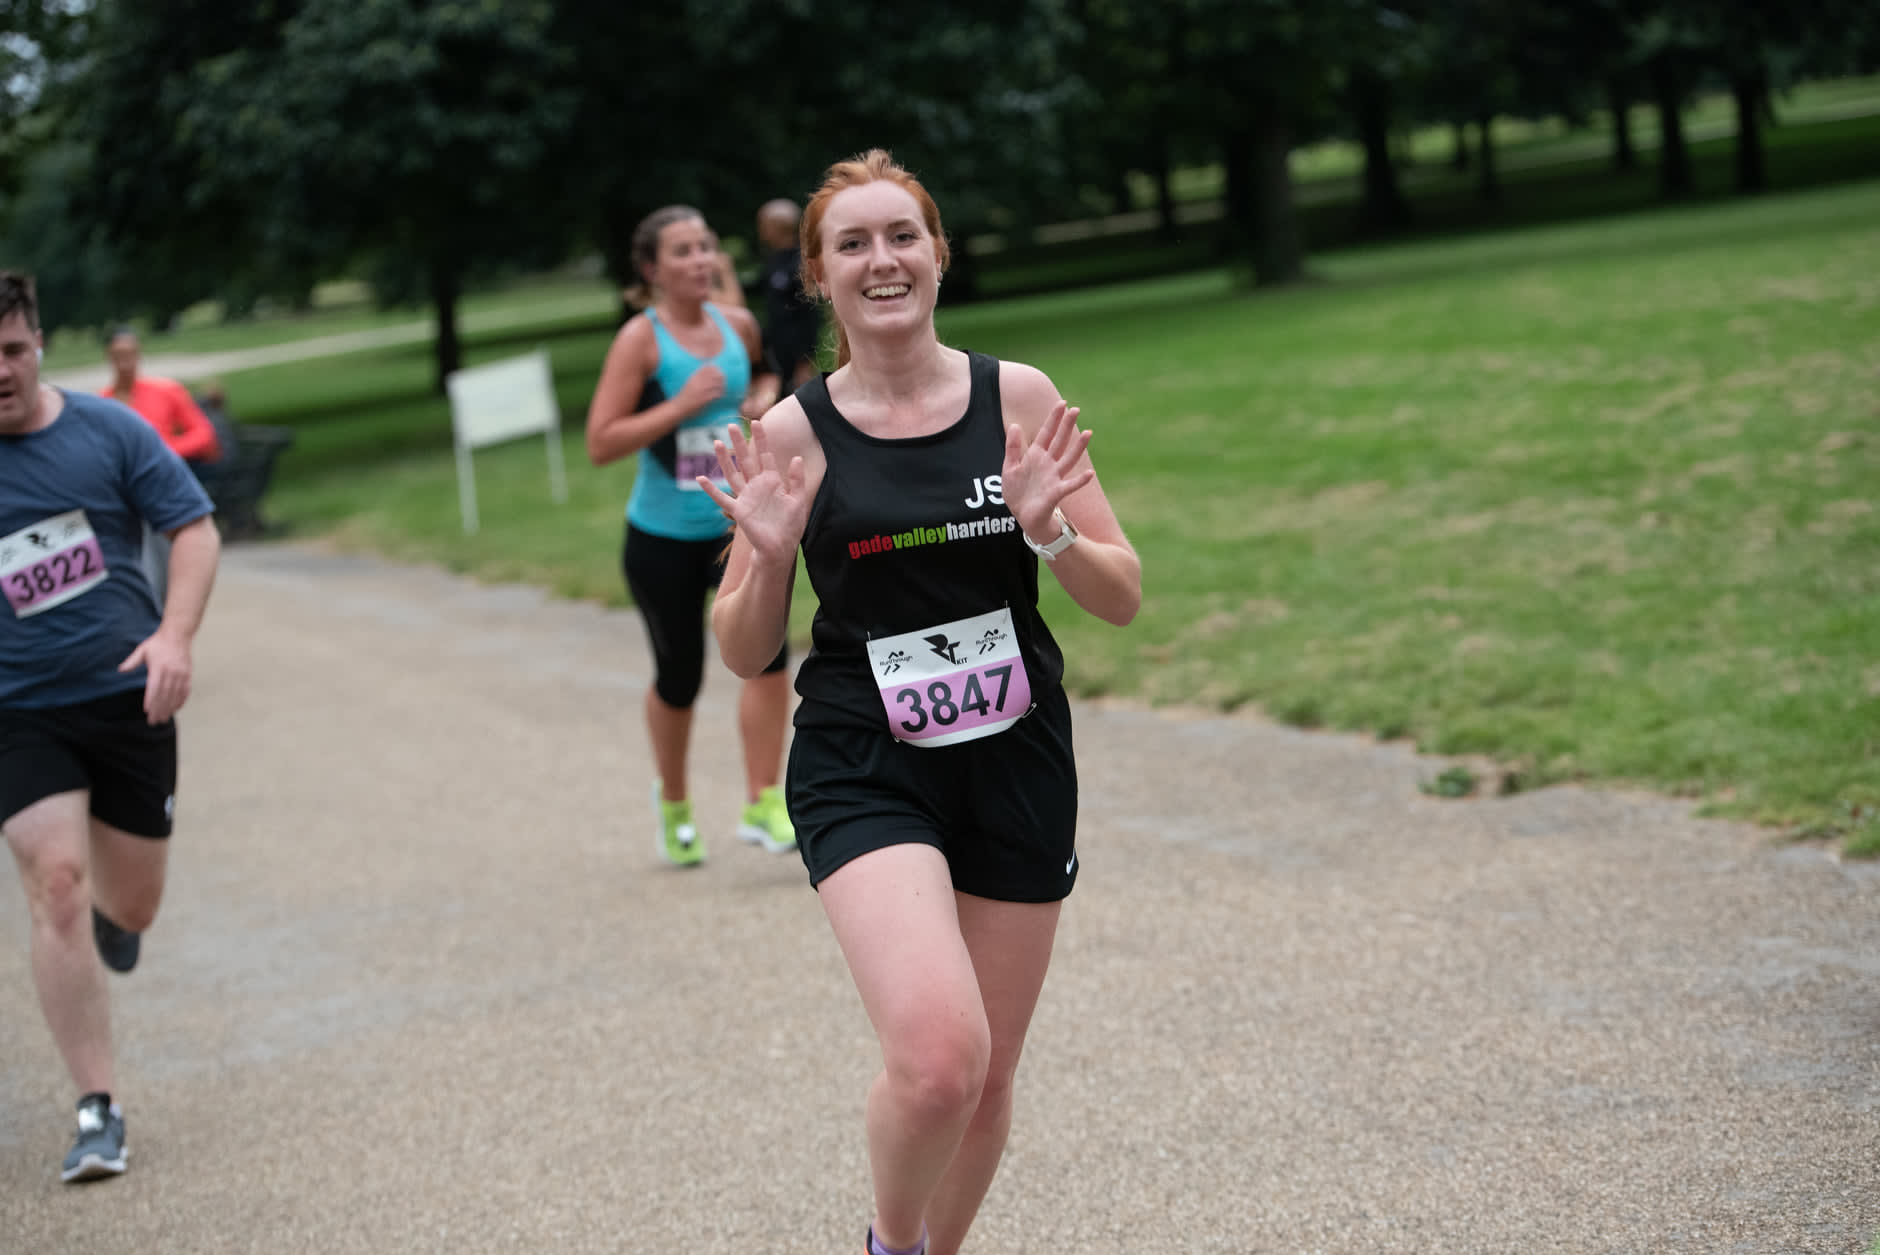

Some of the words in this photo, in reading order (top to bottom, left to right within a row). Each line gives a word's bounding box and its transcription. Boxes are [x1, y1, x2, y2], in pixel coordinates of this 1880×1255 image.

[848, 516, 1016, 559] gadevalleyharriers
[12, 547, 97, 602] 3822
[956, 657, 968, 665] KIT
[896, 664, 1012, 732] 3847
